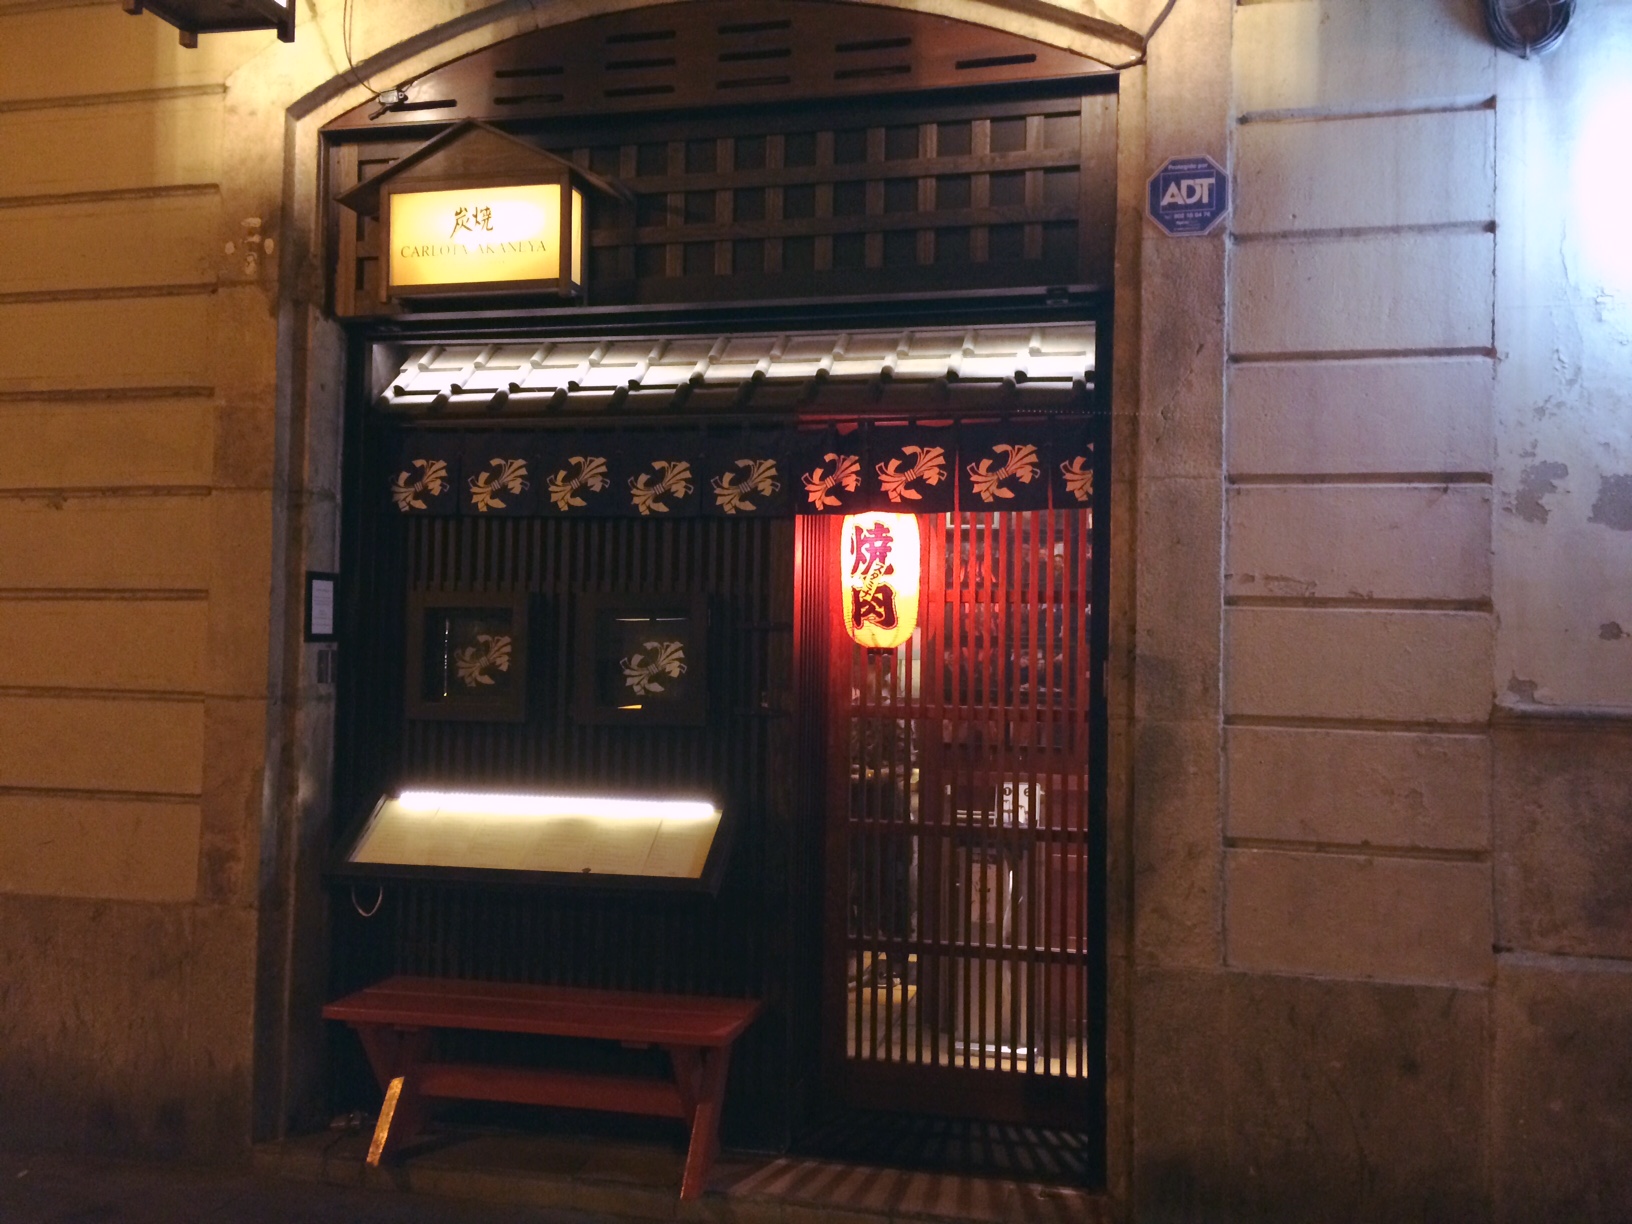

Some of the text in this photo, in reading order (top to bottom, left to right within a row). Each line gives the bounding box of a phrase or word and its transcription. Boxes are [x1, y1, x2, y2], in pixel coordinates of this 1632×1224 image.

[1160, 178, 1215, 206] ADT
[850, 522, 898, 630] 焼肉
[861, 563, 886, 599] スタミナ
